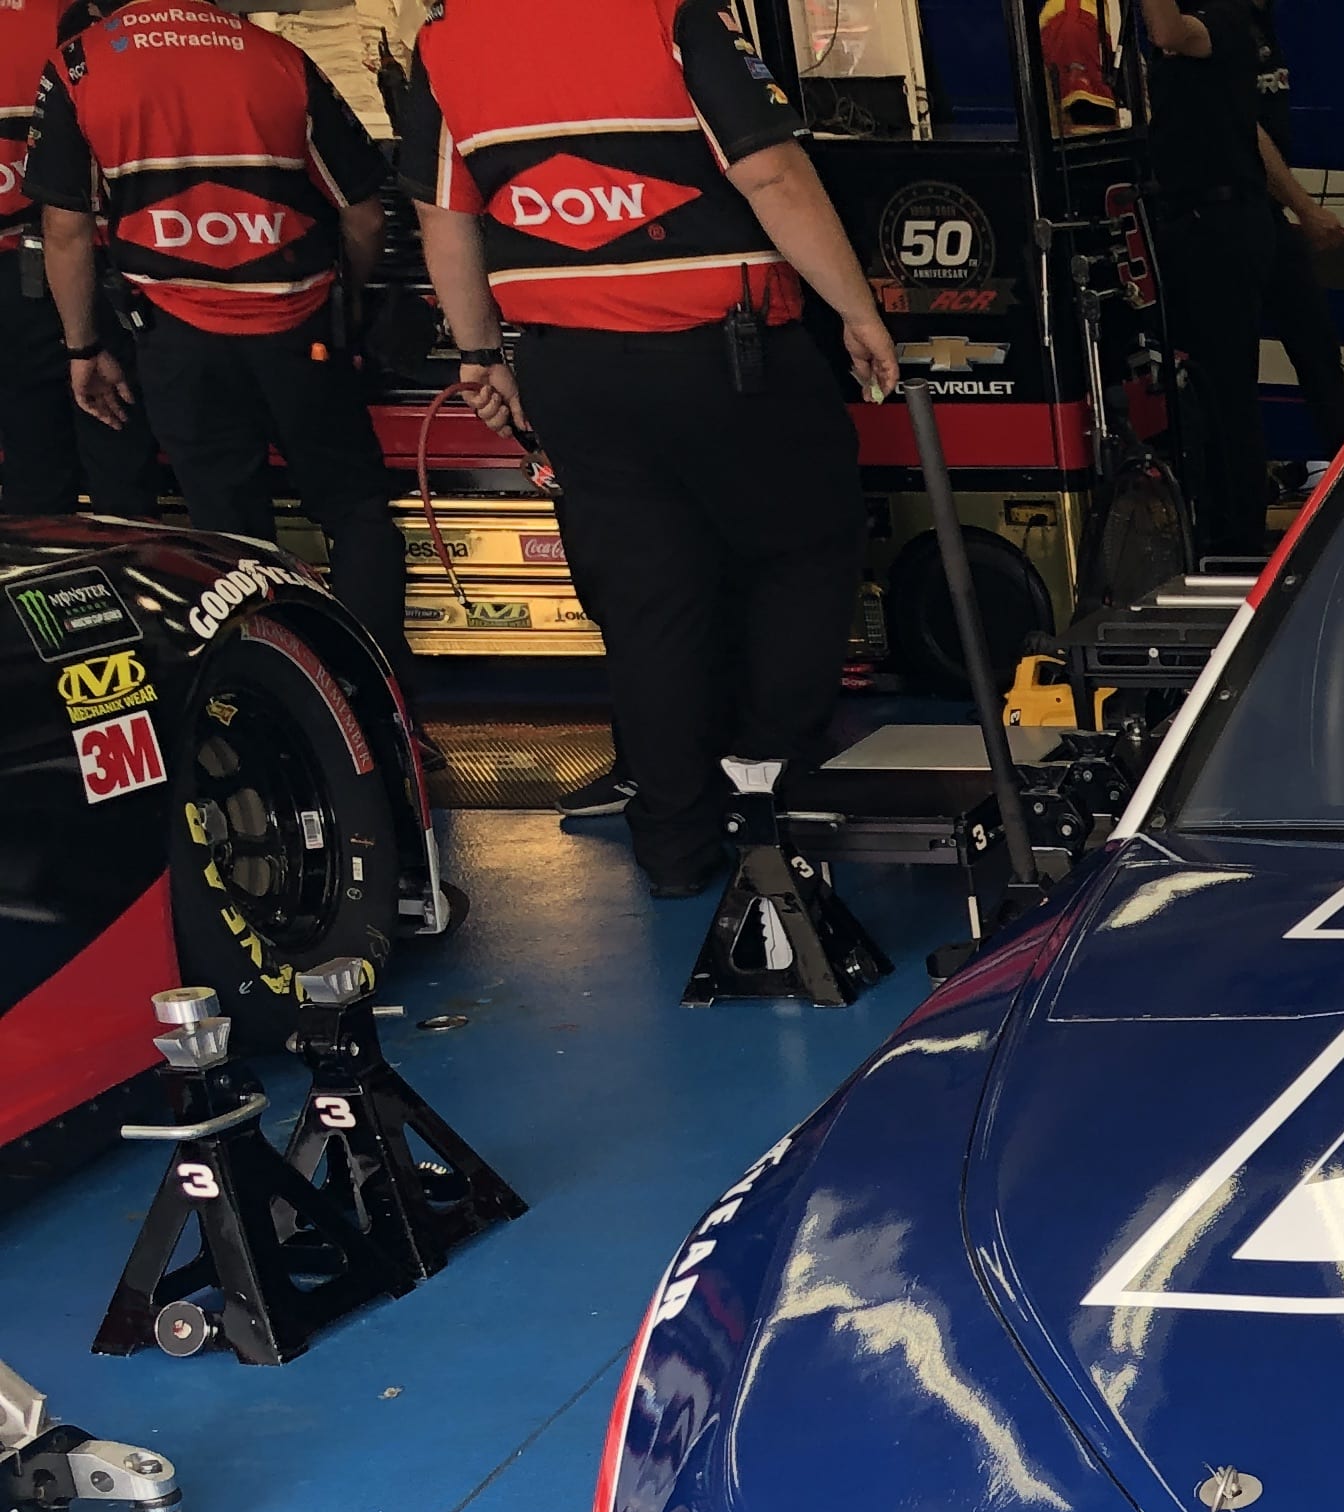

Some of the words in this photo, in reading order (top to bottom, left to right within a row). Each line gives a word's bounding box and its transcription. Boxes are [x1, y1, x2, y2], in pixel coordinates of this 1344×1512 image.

[122, 9, 242, 29] DowRacing
[133, 32, 244, 50] RCRracing
[510, 183, 645, 226] DOW
[148, 210, 286, 248] DOW
[900, 220, 973, 266] 50
[913, 268, 968, 279] ANNIVERSARY
[895, 381, 1015, 395] CEVROLET
[67, 698, 123, 723] MECHANIX
[124, 685, 158, 711] WEAR
[82, 718, 163, 796] 3M
[972, 824, 988, 850] 3
[791, 855, 814, 878] 3
[315, 1096, 356, 1128] 3
[177, 1163, 219, 1198] 3
